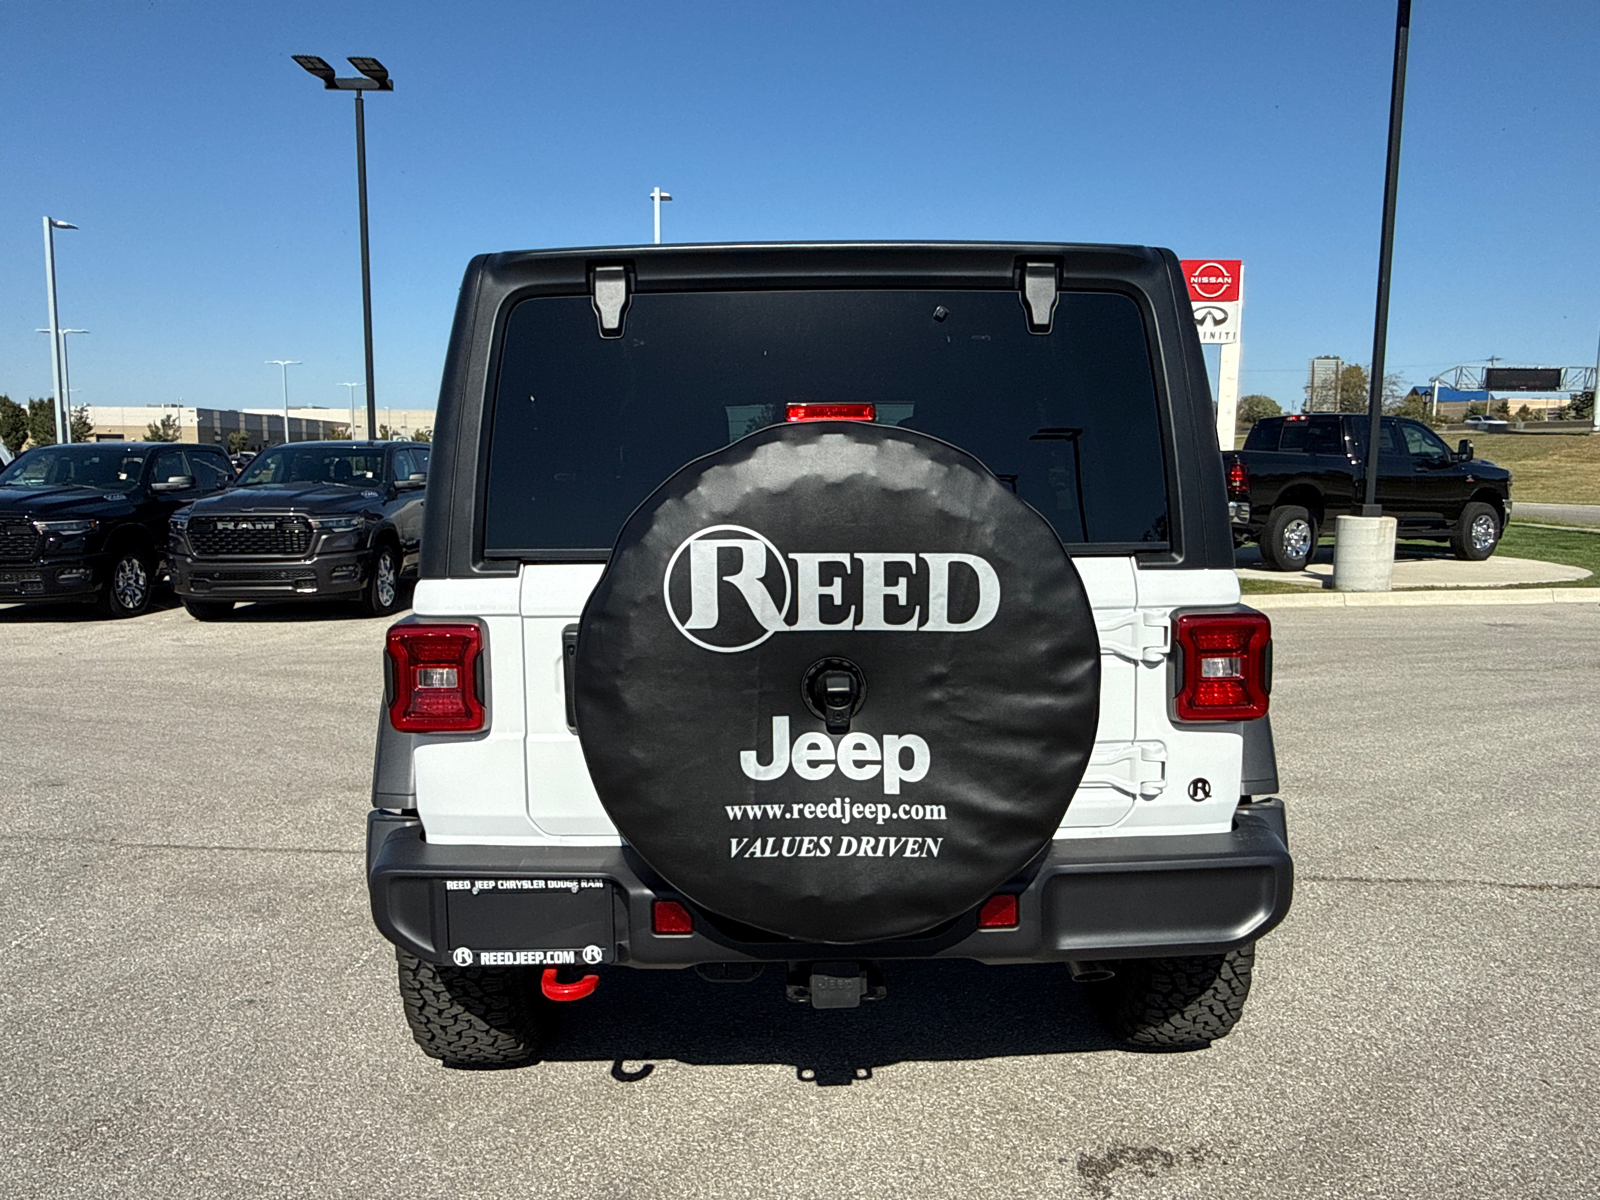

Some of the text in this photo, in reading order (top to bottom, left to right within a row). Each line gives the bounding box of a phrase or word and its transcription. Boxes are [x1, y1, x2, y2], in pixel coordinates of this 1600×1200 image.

[1190, 276, 1232, 284] NISSAN
[1198, 331, 1236, 340] INITI
[216, 521, 276, 530] RAM
[683, 538, 1001, 632] REED
[739, 715, 931, 795] Jeep
[724, 797, 948, 825] www.reedjeep.com
[729, 836, 944, 859] VALUES DRIVEN
[446, 880, 471, 891] REED
[473, 880, 496, 890] JEEP
[497, 879, 546, 890] CHRYSLER
[580, 879, 604, 889] RAM
[480, 951, 575, 966] REEDJEEP.COM
[817, 976, 854, 992] Jeep
